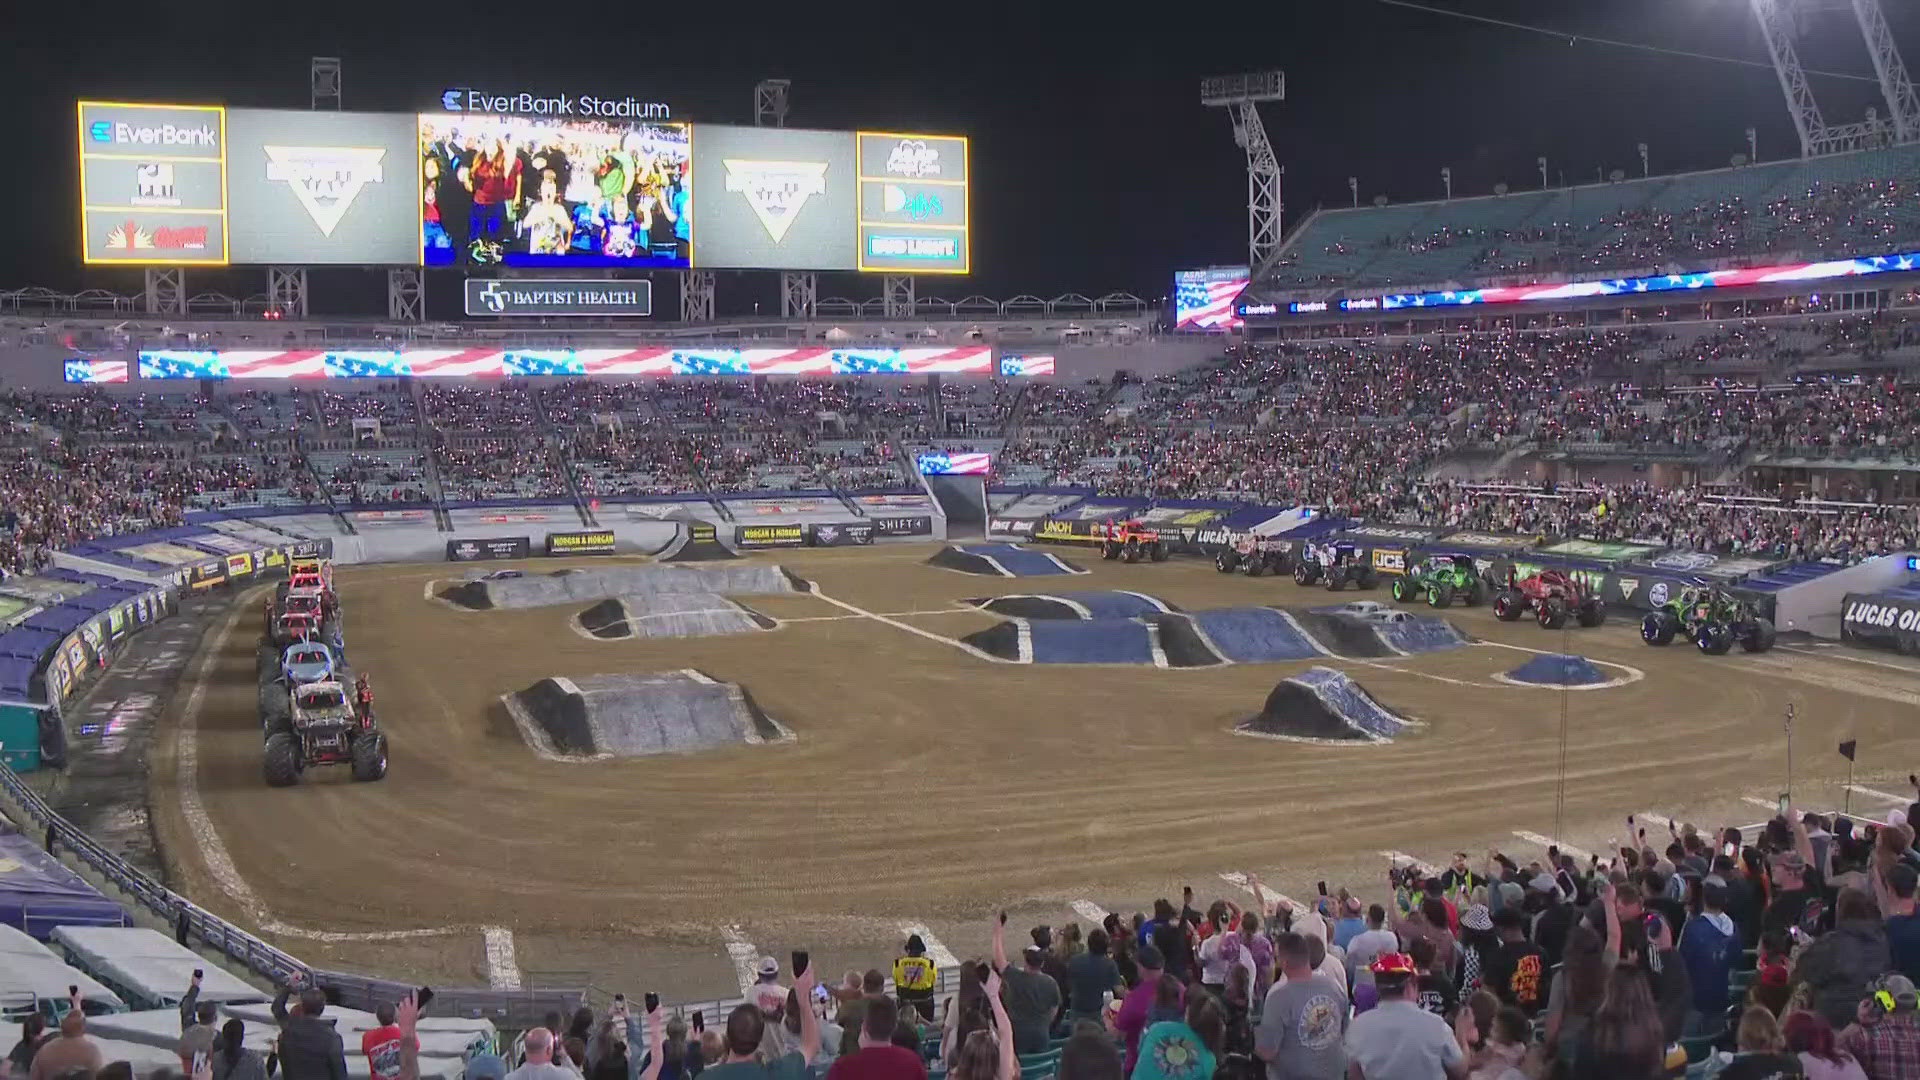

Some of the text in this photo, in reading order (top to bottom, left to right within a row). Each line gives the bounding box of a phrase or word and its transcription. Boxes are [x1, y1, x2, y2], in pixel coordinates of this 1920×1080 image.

[468, 91, 670, 118] EverBank Stadium
[115, 121, 216, 146] EverBank
[513, 291, 638, 305] BAPTIST HEALTH
[879, 519, 912, 530] SHIFT
[1044, 519, 1073, 534] UNOH
[1198, 529, 1228, 545] LUCAS
[1376, 553, 1405, 569] JCB
[1845, 601, 1898, 628] LUCAS
